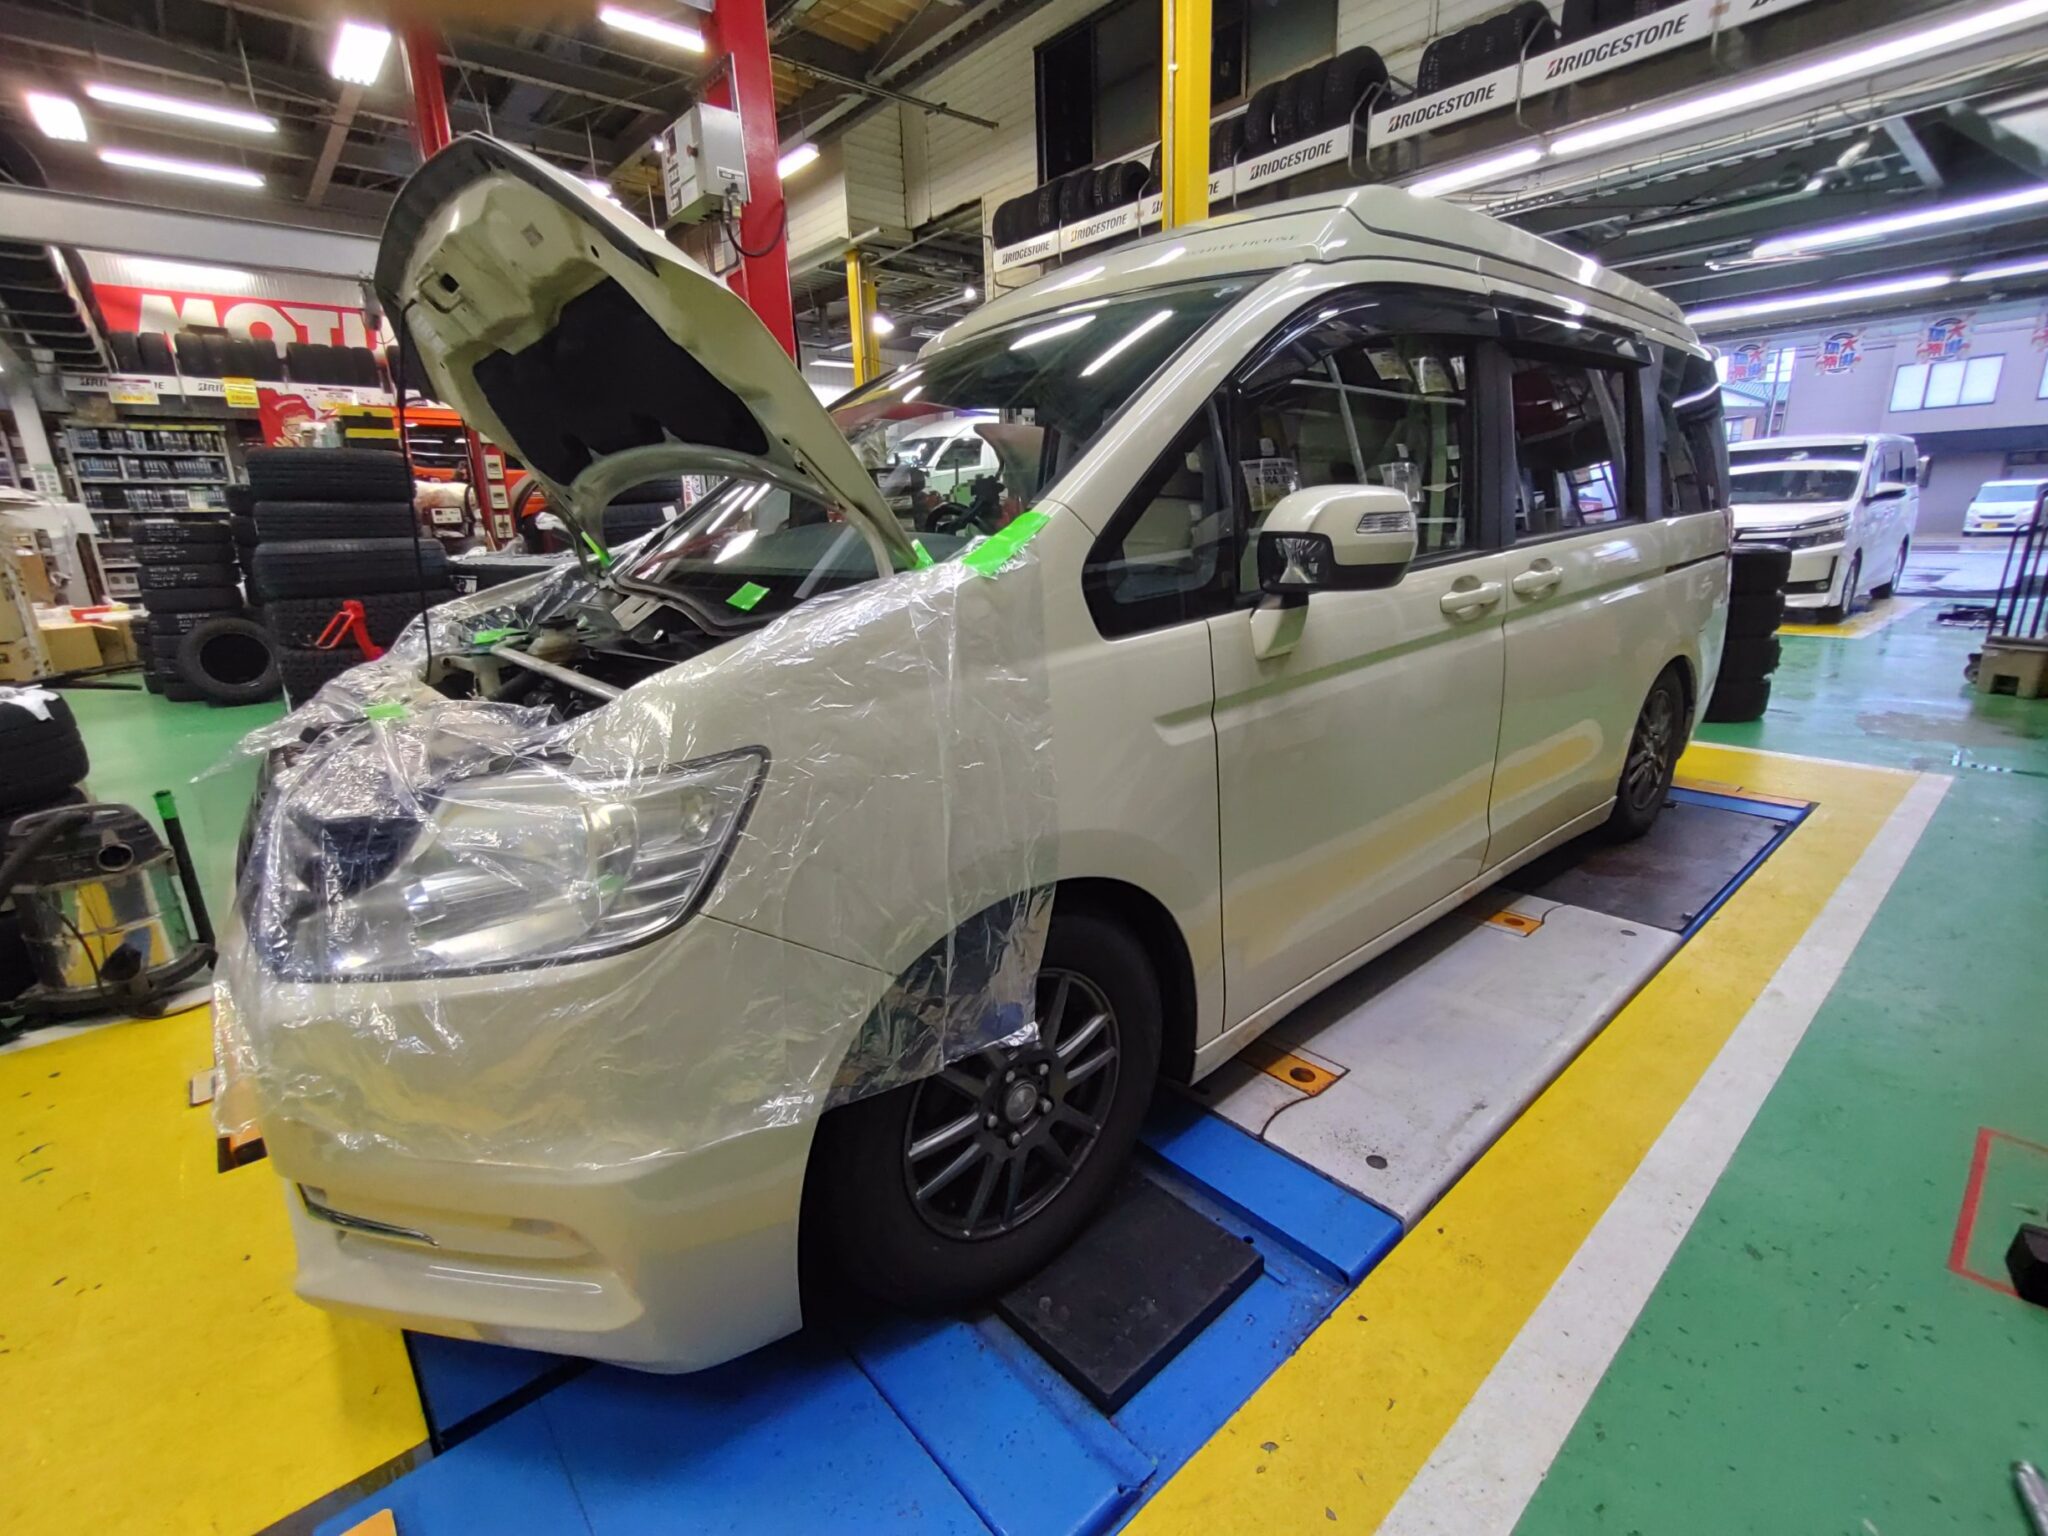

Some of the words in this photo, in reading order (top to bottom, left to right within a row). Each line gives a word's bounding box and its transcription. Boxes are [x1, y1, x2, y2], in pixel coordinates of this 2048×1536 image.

[1544, 13, 1690, 80] BRIDGESTONE
[1387, 82, 1497, 134] BRIDGESTONE
[1250, 139, 1334, 181] BRIDGESTONE
[1070, 212, 1128, 243] BRIDGESTONE
[1002, 240, 1050, 265] BRIDGESTONE
[138, 293, 399, 359] MOTU
